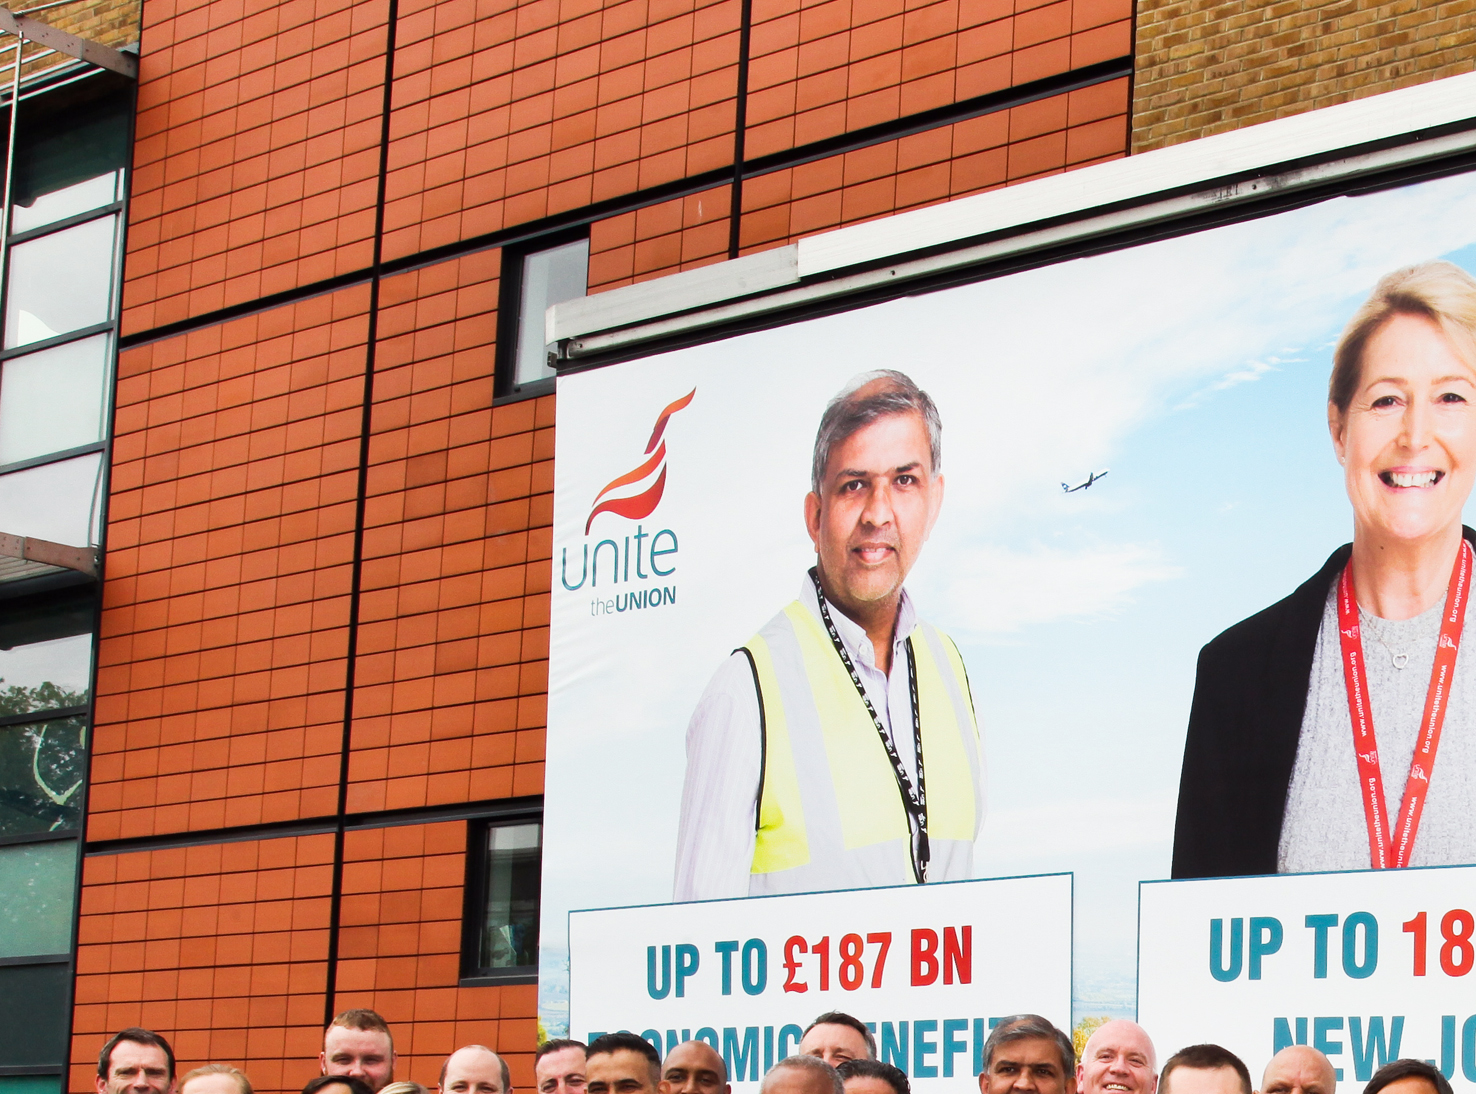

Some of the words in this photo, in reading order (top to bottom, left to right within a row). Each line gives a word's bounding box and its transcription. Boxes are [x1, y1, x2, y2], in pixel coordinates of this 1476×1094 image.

[562, 525, 678, 591] unite
[1350, 651, 1368, 737] www.unitetheunion.org
[1422, 664, 1448, 754] www.unitetheunion.org
[647, 943, 700, 1000] UP
[714, 937, 768, 996] TO
[782, 931, 892, 994] £187
[910, 924, 973, 987] BN
[1209, 915, 1283, 983] UP
[1304, 911, 1379, 980] TO
